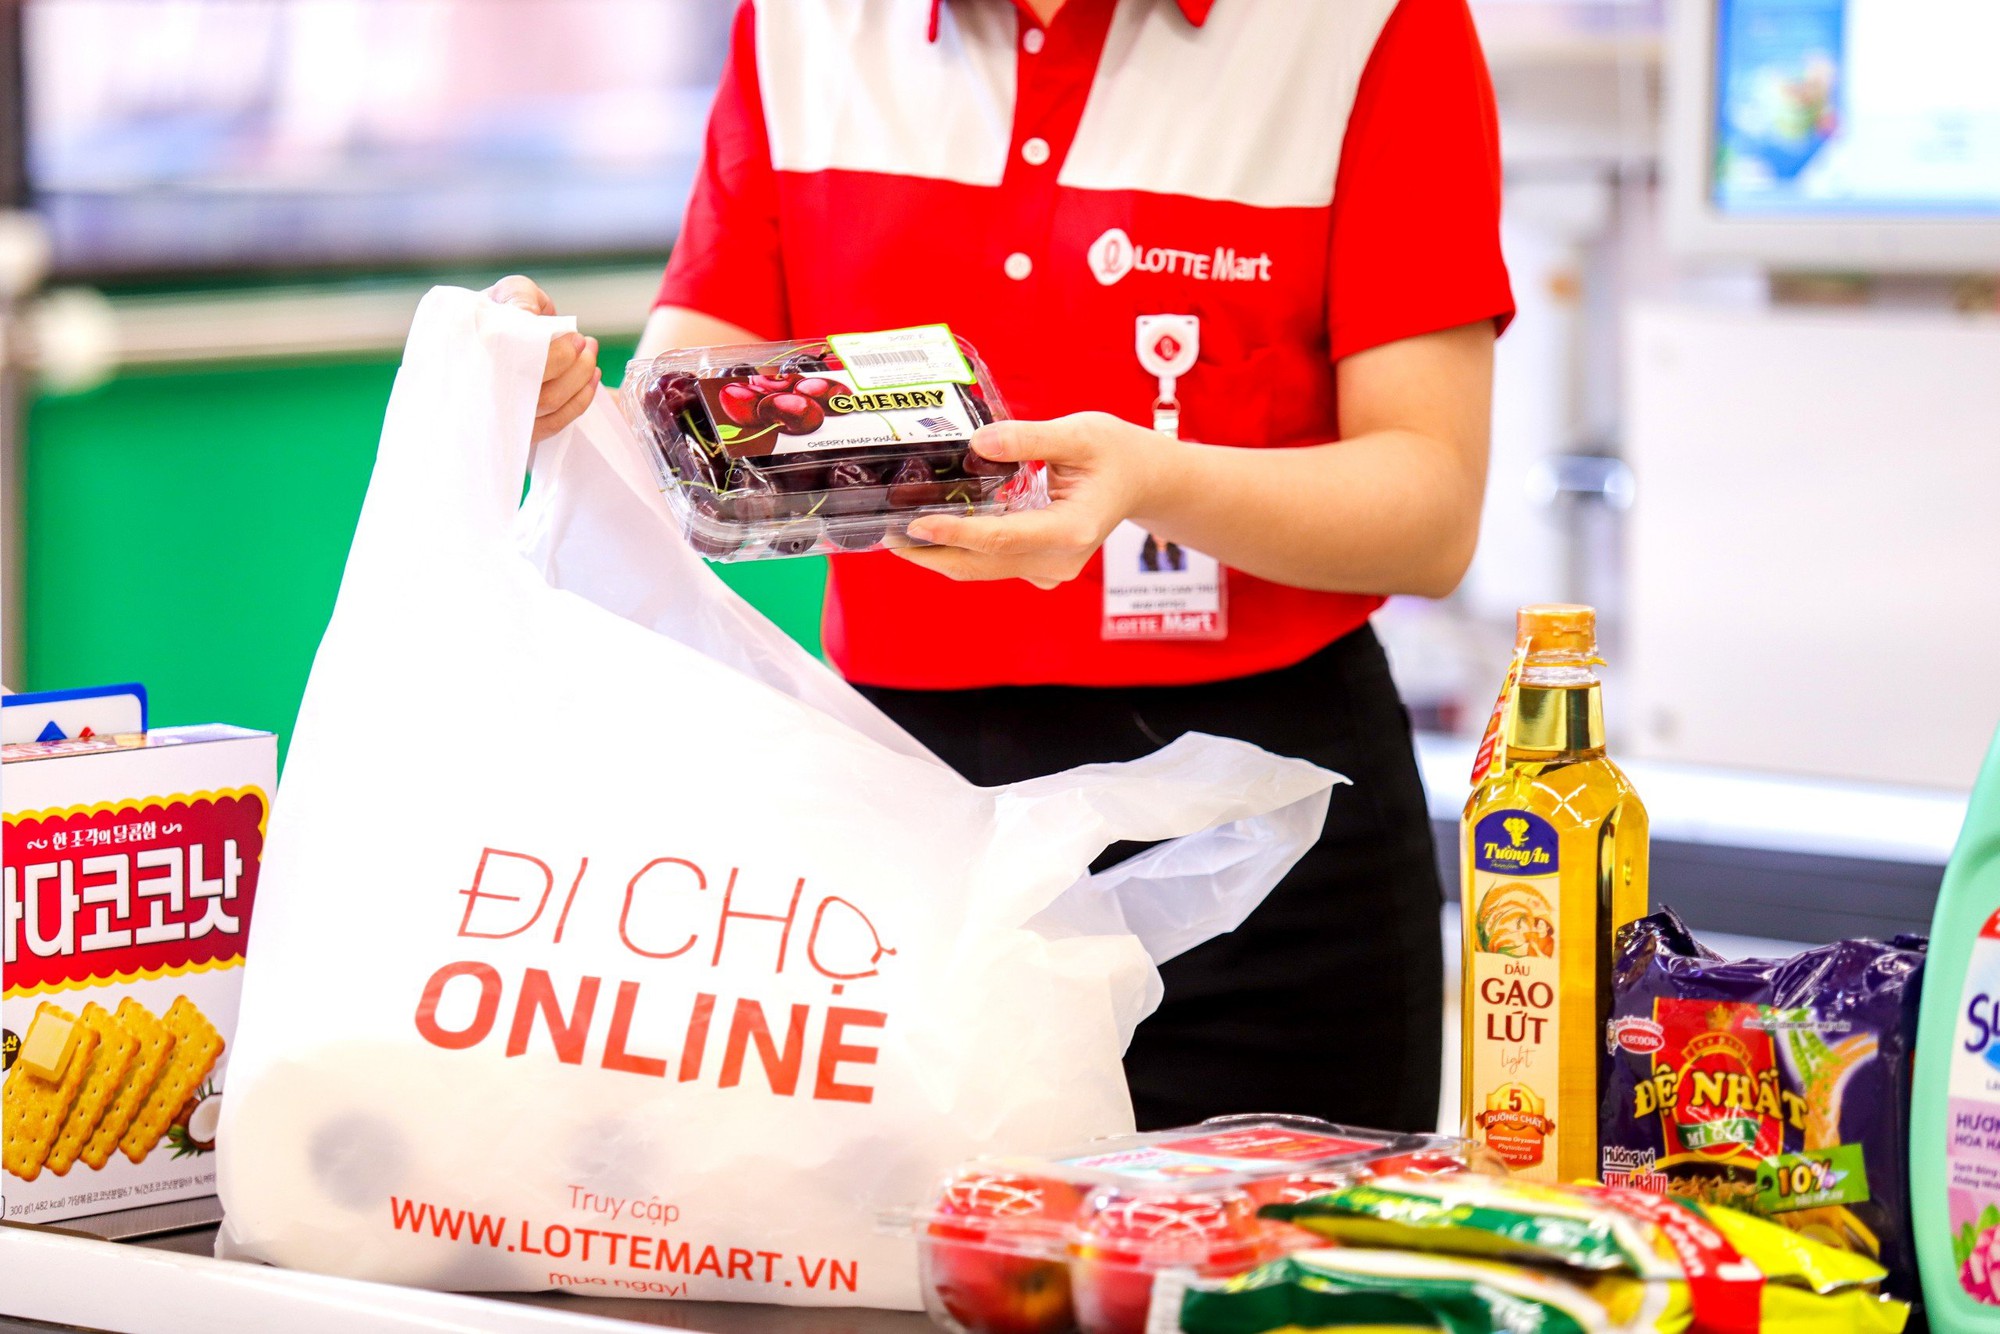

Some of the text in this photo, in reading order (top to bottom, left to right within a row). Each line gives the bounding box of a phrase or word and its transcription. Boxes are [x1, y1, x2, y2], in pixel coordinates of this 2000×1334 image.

[1134, 244, 1272, 282] LOTTE Mart
[829, 390, 944, 414] CHERRY
[52, 831, 68, 851] 한
[1481, 977, 1554, 1009] GẠO
[415, 960, 888, 1105] ONLINE
[1487, 1010, 1549, 1045] LỨT
[1509, 1088, 1522, 1113] 5
[567, 1184, 680, 1227] Truy cập
[389, 1195, 860, 1294] WWW.LOTTEMART.VN
